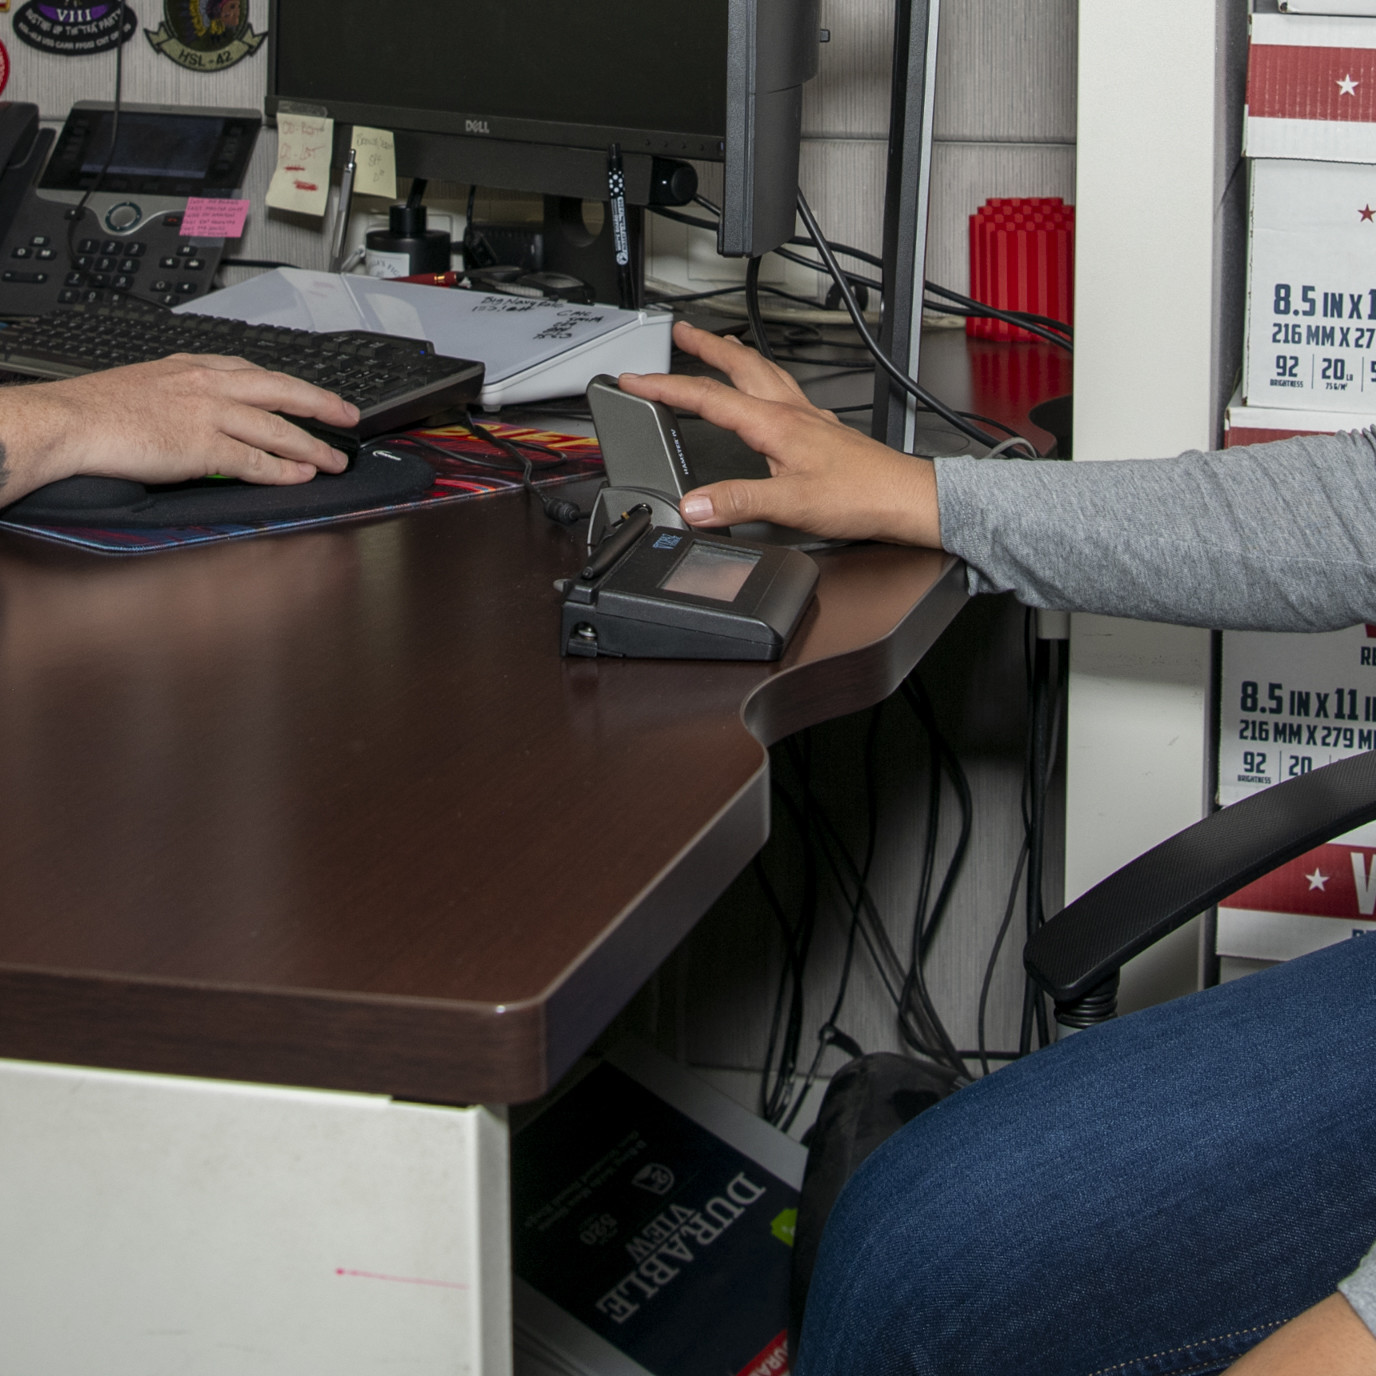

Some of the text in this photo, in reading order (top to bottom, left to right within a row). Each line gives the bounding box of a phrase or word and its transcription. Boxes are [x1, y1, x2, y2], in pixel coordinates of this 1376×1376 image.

[55, 8, 92, 22] VIII
[177, 49, 233, 67] HSL-42
[465, 119, 490, 134] DELL
[1273, 283, 1316, 317] 8.5
[1323, 291, 1344, 319] IN
[1348, 292, 1362, 320] X
[1272, 322, 1303, 344] 216
[1306, 324, 1335, 347] MM
[1338, 327, 1351, 348] X
[1275, 355, 1299, 378] 92
[1321, 358, 1345, 381] 20
[1269, 379, 1304, 388] BRIGHTNESS
[670, 428, 690, 476] HAMSTER IV
[1240, 680, 1283, 715] 8.5
[1289, 690, 1310, 716] IN
[1315, 691, 1330, 718] X
[1334, 687, 1359, 719] 11
[1239, 719, 1269, 742] 216
[1273, 721, 1302, 744] MM
[1305, 724, 1318, 746] X
[1321, 725, 1354, 748] 279
[1243, 751, 1313, 777] 92 20
[1237, 774, 1272, 785] BRIGHTNESS
[626, 1203, 695, 1262] VIEW
[595, 1171, 767, 1323] DURABLE
